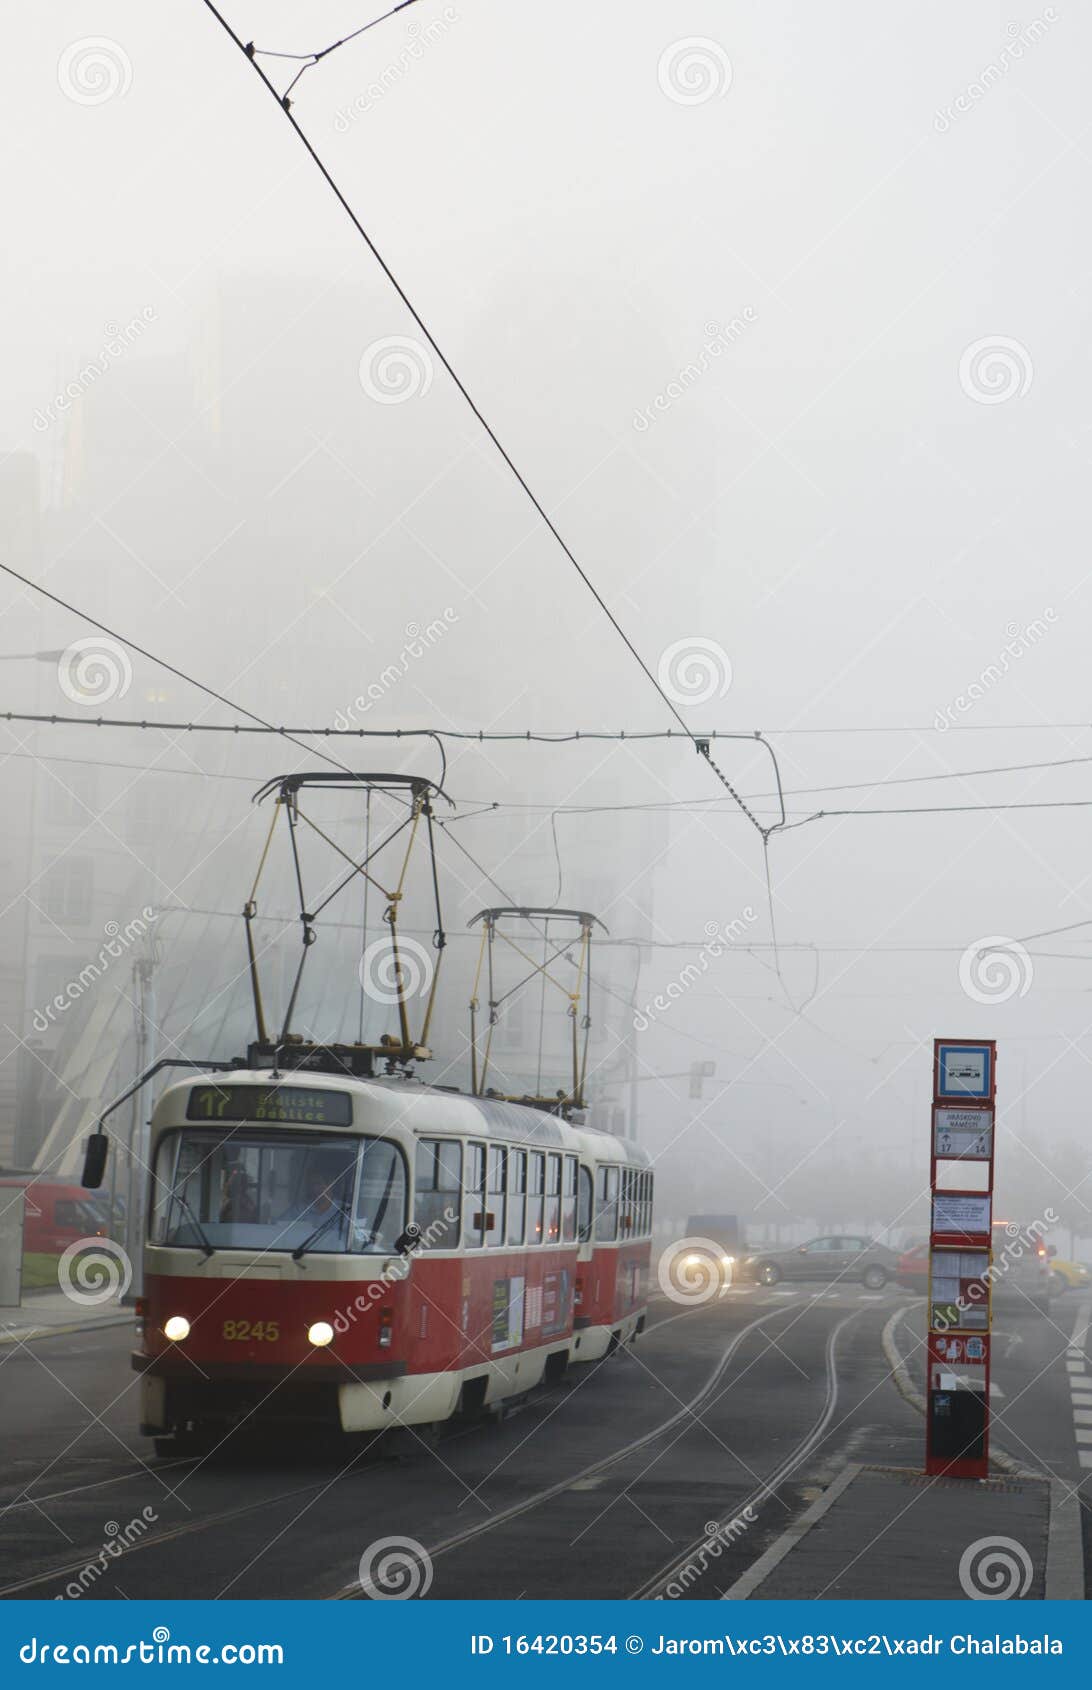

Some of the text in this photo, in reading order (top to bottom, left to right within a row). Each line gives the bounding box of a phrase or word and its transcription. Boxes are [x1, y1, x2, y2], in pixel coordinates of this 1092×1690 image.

[199, 1090, 232, 1117] 17
[941, 1144, 952, 1152] 17
[976, 1145, 986, 1153] 14
[223, 1320, 280, 1342] 8245
